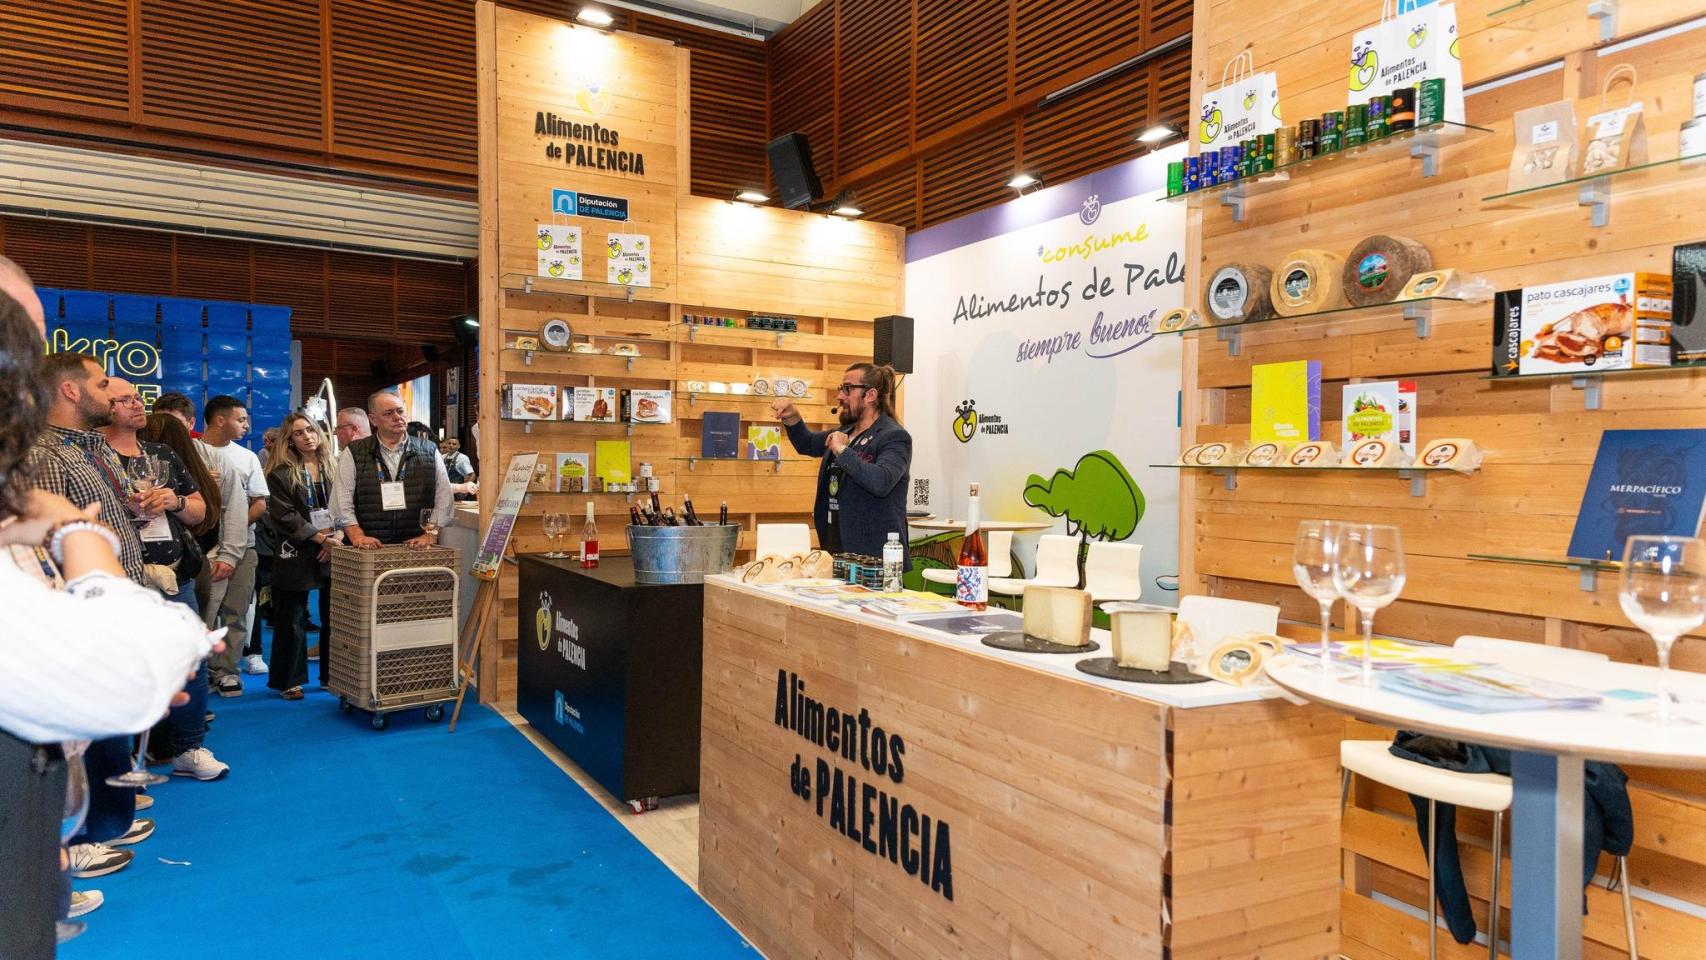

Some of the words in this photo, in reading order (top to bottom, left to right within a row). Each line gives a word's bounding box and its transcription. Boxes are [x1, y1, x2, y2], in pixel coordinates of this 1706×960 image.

[1381, 56, 1416, 78] Alimentos
[1393, 61, 1427, 84] PALENCIA
[535, 111, 619, 146] Alimentos
[1224, 117, 1249, 133] Alimentos
[1233, 122, 1256, 139] PALENCIA
[546, 142, 562, 159] de
[565, 142, 645, 175] PALENCIA
[579, 196, 618, 209] Diputación
[579, 206, 590, 214] DE
[591, 207, 627, 218] PALENCIA
[1038, 223, 1149, 264] #consume
[953, 274, 1073, 325] Alimentos
[1082, 266, 1115, 301] de
[1527, 292, 1552, 304] pato
[1553, 282, 1612, 299] cascajares
[1508, 305, 1521, 359] cascajares
[1016, 330, 1082, 364] siempre
[978, 413, 1002, 424] Alimentos
[986, 424, 1009, 434] PALENCIA
[1609, 484, 1682, 495] MERPACÍFICO
[556, 610, 579, 641] Alimentos
[563, 638, 586, 671] PALENCIA
[775, 668, 906, 784] Alimentos
[790, 753, 811, 801] de
[816, 757, 954, 902] PALENCIA
